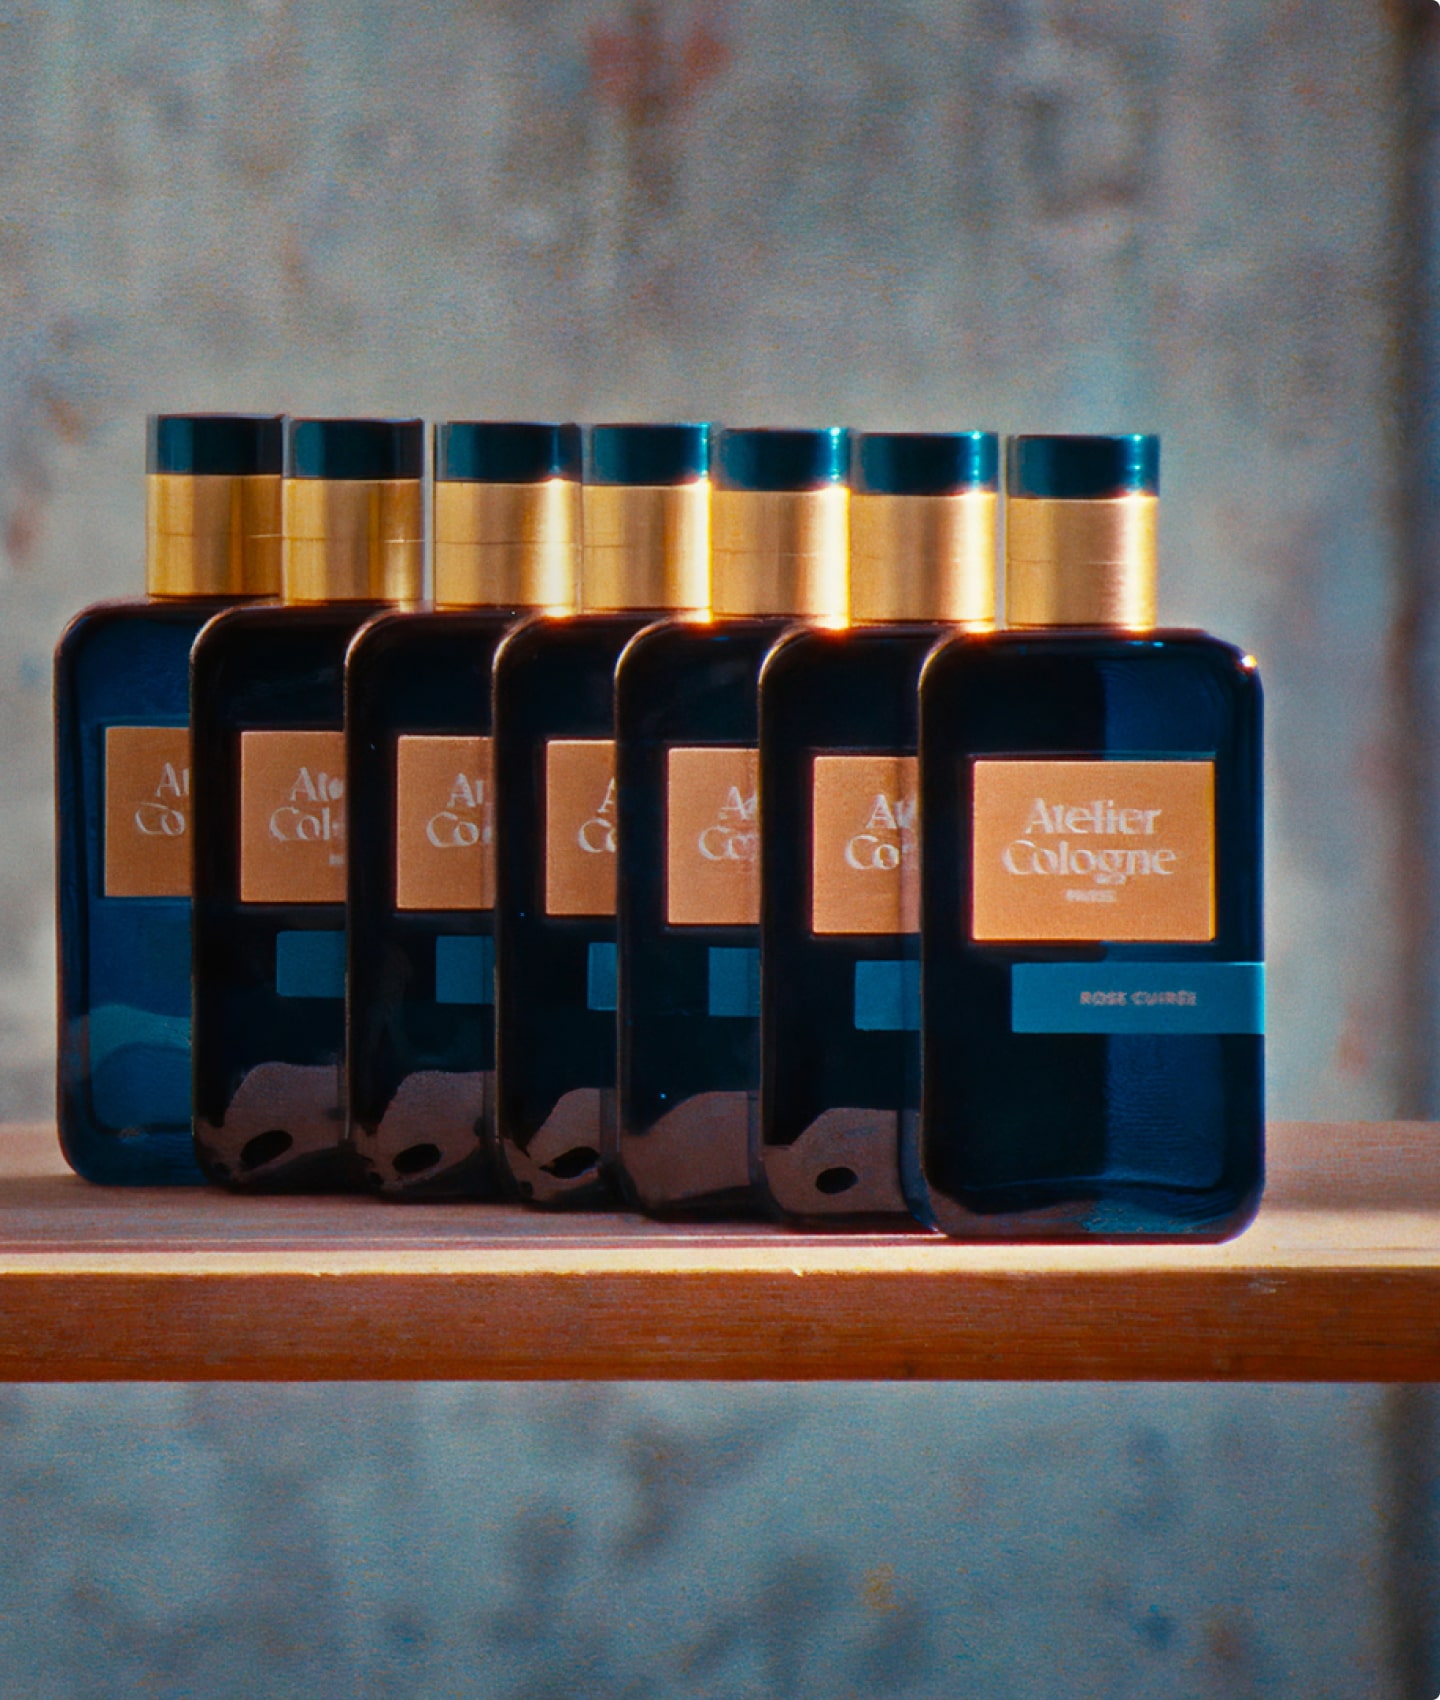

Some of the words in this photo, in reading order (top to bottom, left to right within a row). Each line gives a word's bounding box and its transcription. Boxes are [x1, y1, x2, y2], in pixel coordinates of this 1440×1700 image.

[1024, 797, 1163, 835] Atelier
[1001, 839, 1177, 885] Cologne
[1079, 991, 1128, 1006] ROSE
